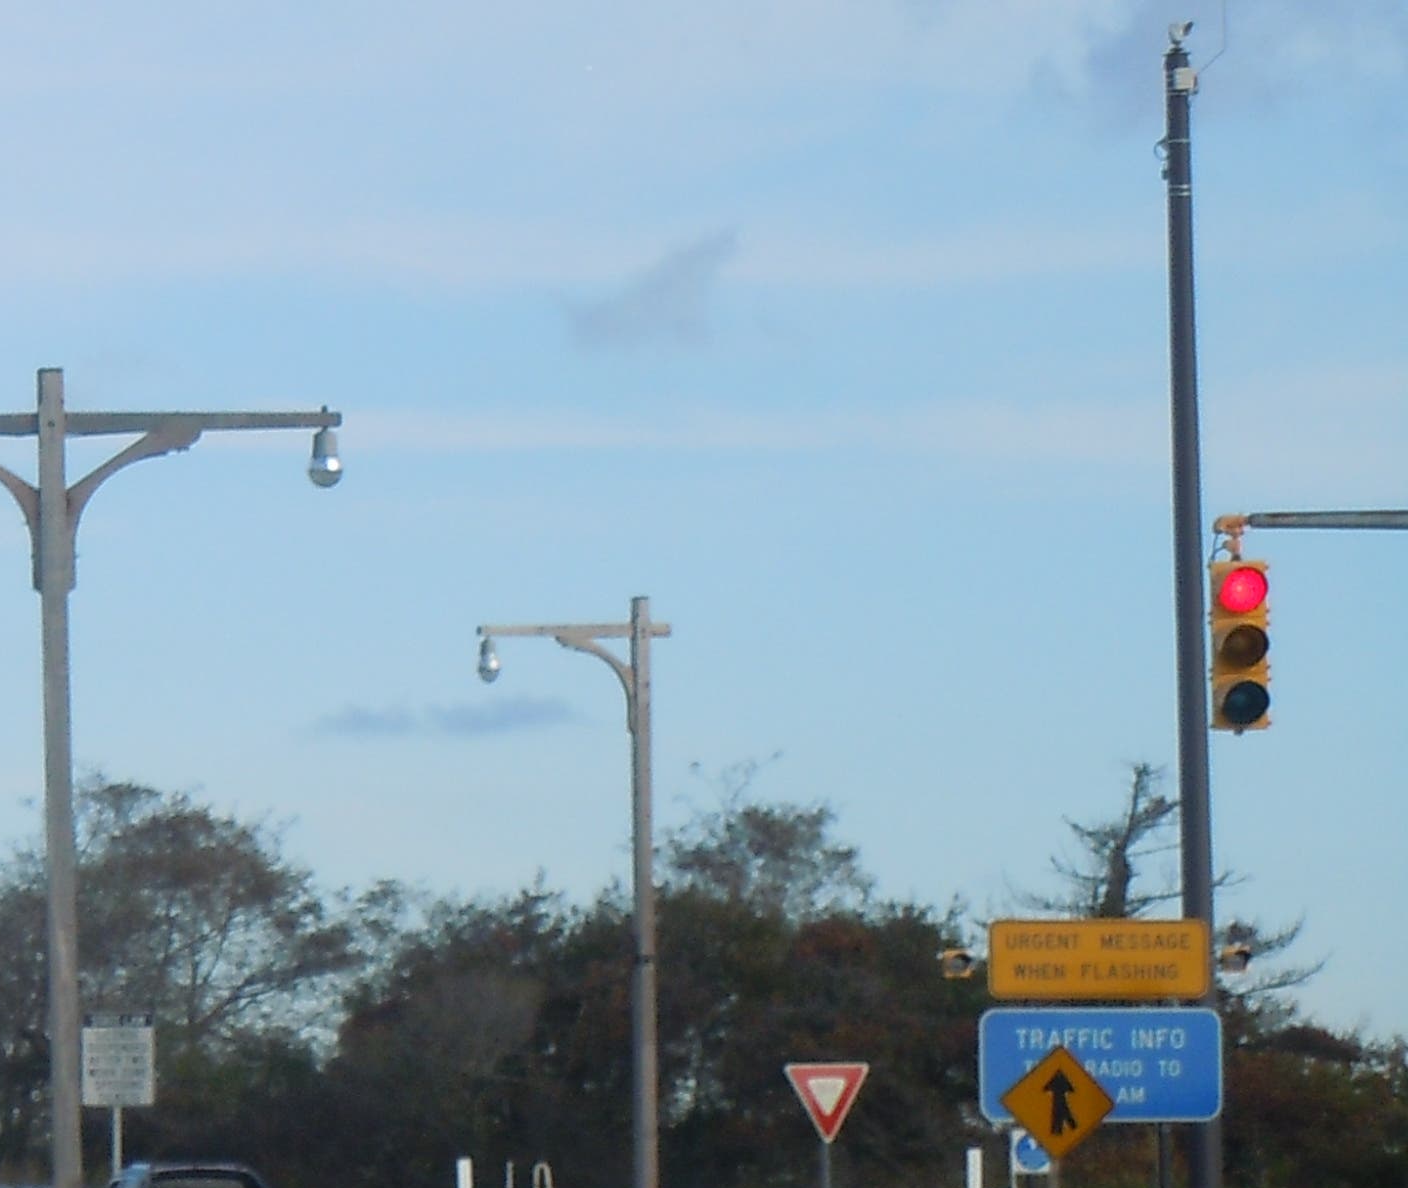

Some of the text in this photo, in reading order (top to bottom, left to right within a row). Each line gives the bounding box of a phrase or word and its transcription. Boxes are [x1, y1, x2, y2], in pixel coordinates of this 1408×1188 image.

[1005, 934, 1191, 949] URGENT MESSAGE
[1014, 963, 1178, 979] WHEN FLASHING
[1016, 1028, 1186, 1049] TRAFFIC INFO
[1084, 1060, 1181, 1077] RADIO TO
[1117, 1087, 1145, 1103] AM
